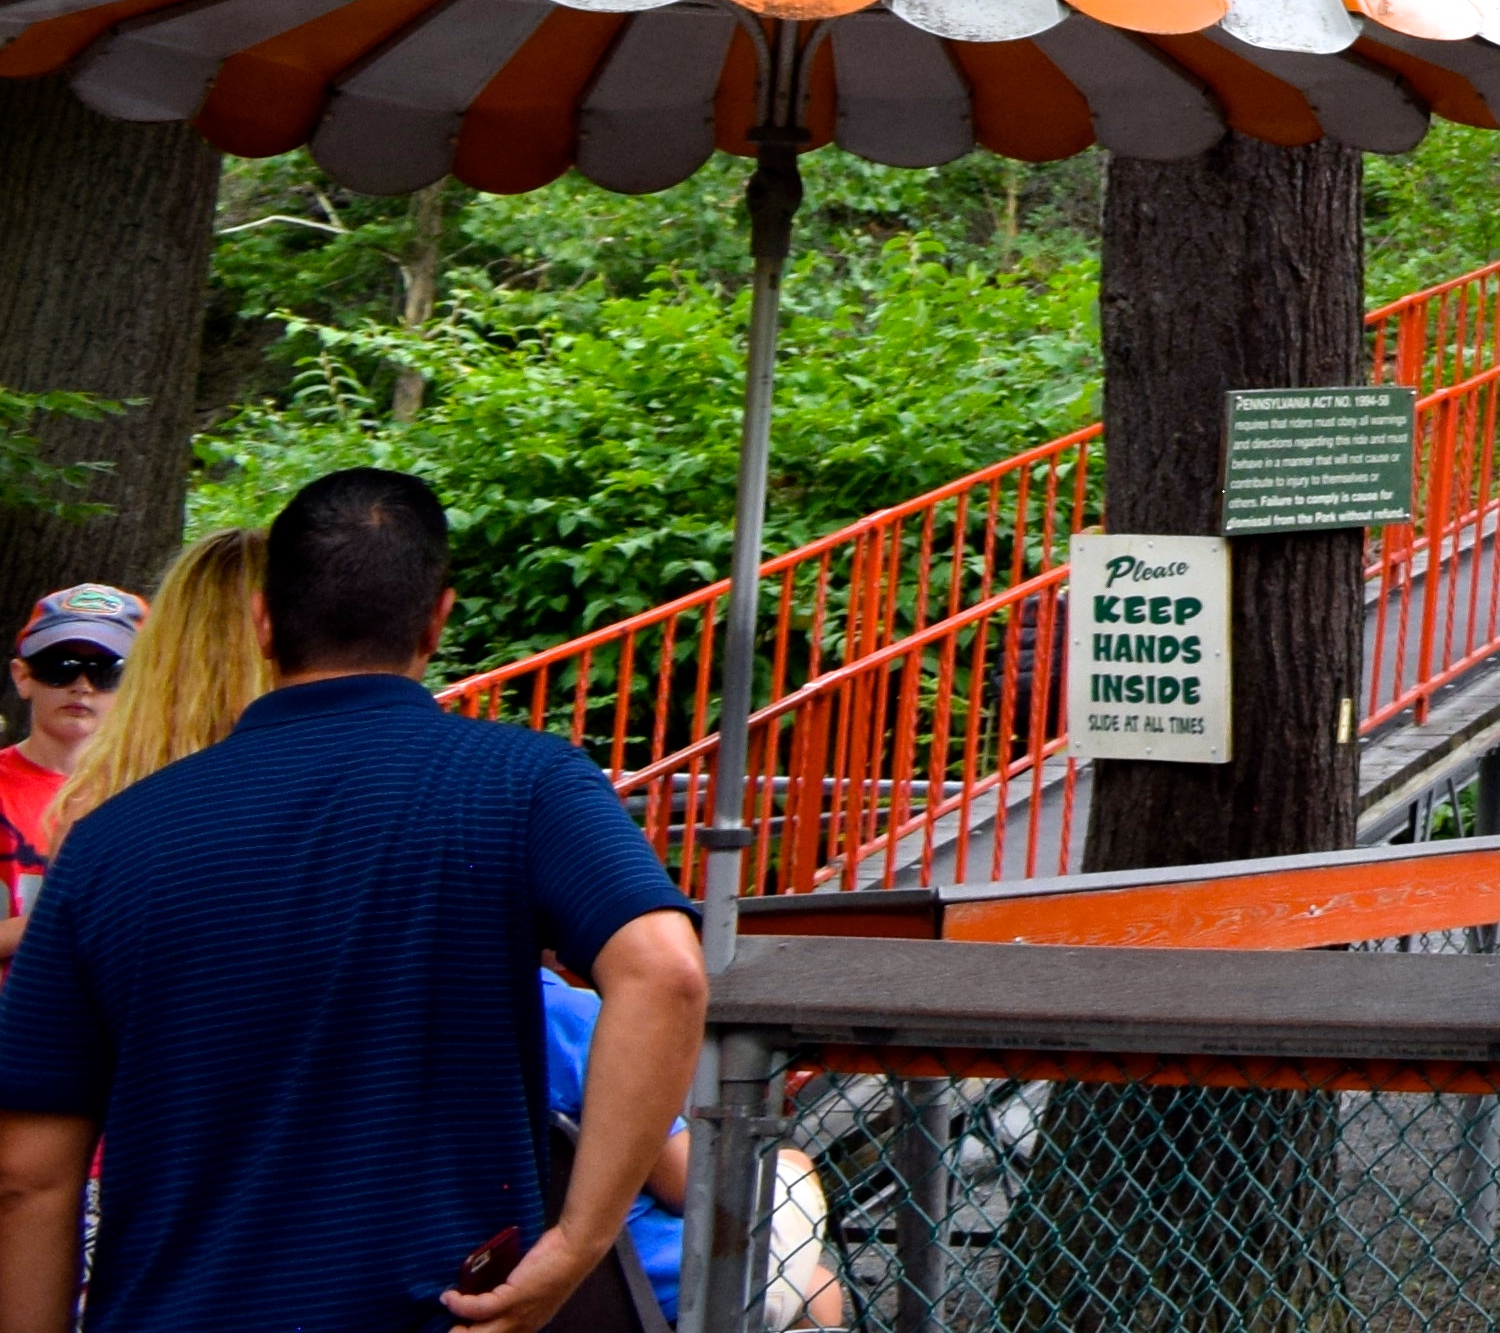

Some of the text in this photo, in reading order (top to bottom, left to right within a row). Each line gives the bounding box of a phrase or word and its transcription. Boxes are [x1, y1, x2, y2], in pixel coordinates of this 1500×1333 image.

[1236, 397, 1310, 410] PENNSYLVANIA
[1312, 396, 1332, 408] ACT
[1334, 395, 1351, 407] NO.
[1270, 418, 1287, 429] that
[1288, 418, 1313, 428] riders
[1314, 417, 1335, 427] must
[1337, 416, 1357, 428] obey
[1370, 416, 1407, 427] warnings
[1233, 434, 1408, 450] and directions regarding this ride and must
[1232, 453, 1400, 469] behave in a manner that will not cause or
[1230, 473, 1379, 488] contribute to injury to themselves or
[1260, 495, 1292, 506] Failure
[1294, 495, 1304, 505] to
[1306, 493, 1339, 505] comply
[1341, 492, 1349, 502] is
[1351, 492, 1378, 502] cause
[1379, 489, 1393, 501] for
[1273, 515, 1296, 525] from
[1297, 514, 1313, 524] the
[1315, 512, 1336, 522] Park
[1338, 510, 1372, 521] without
[1105, 555, 1189, 588] Please
[1094, 595, 1203, 625] KEEP
[1093, 634, 1202, 664] HANDS
[1091, 674, 1201, 705] INSIDE
[1088, 714, 1204, 734] SLIDE AT ALL TIMES
